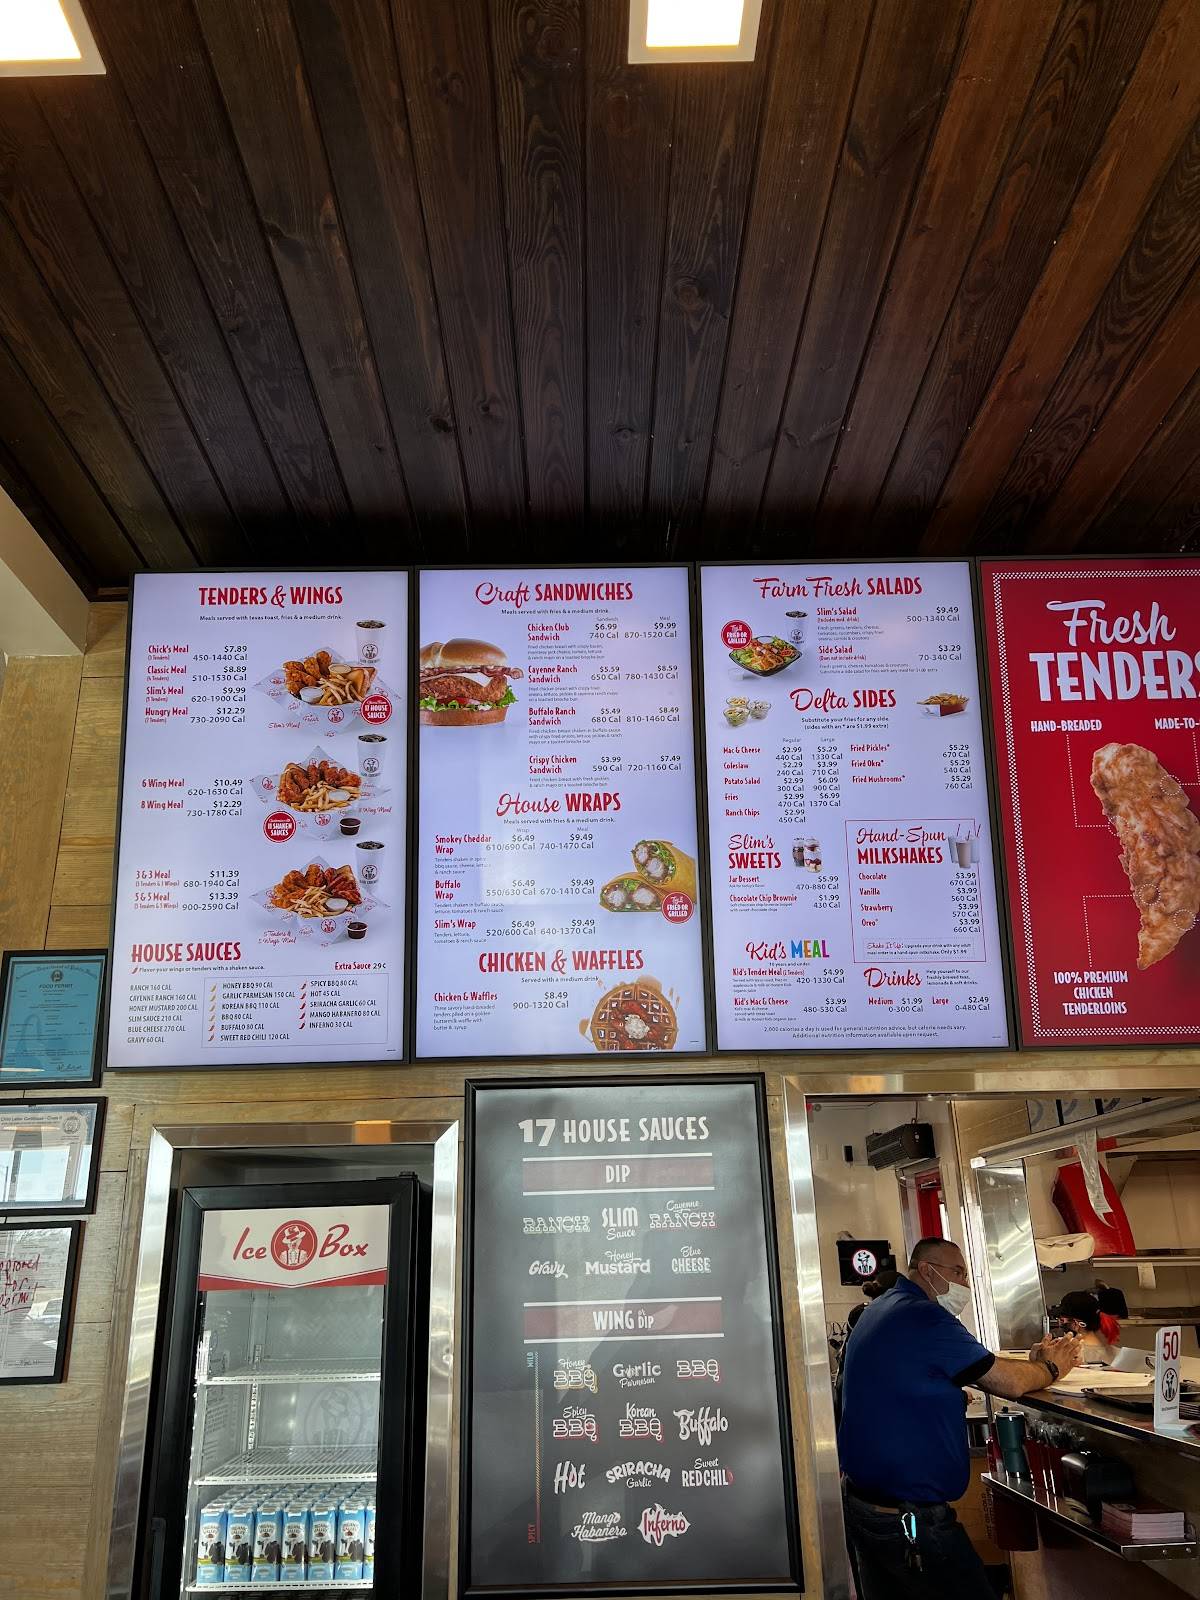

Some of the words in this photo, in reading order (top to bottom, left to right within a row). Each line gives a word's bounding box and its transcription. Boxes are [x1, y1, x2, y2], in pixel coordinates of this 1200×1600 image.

[476, 582, 530, 608] Craft
[535, 583, 633, 601] SANDWICHES
[753, 577, 809, 599] Farm
[806, 576, 863, 598] Fresh
[867, 577, 922, 596] SALADS
[199, 587, 267, 606] TENDERS
[271, 586, 286, 608] &
[290, 586, 343, 605] WINGS
[817, 608, 838, 616] Slim's
[839, 607, 857, 615] Salad
[654, 622, 676, 630] $9.99
[1046, 599, 1176, 647] Fresh
[528, 633, 560, 641] Sandwich
[148, 645, 171, 653] Chick's
[173, 645, 188, 653] Meal
[224, 645, 247, 653] $7.89
[819, 646, 833, 654] Side
[148, 666, 169, 674] Classic
[171, 666, 186, 674] Meal
[224, 666, 246, 674] $8.89
[1029, 650, 1200, 702] TENDER
[790, 688, 849, 713] Delta
[853, 690, 897, 708] SIDES
[146, 708, 170, 717] Hungry
[172, 708, 188, 716] Meal
[217, 707, 245, 716] $12.29
[529, 707, 554, 716] Buffalo
[556, 707, 576, 715] Ranch
[1031, 719, 1102, 732] HAND-BREADED
[1155, 718, 1200, 730] MADE-TO-
[723, 746, 734, 754] Mac
[148, 779, 166, 789] Wing
[168, 779, 184, 787] Meal
[214, 778, 242, 787] $10.49
[496, 793, 560, 816] House
[565, 793, 621, 812] WRAPS
[435, 835, 462, 844] Smokey
[464, 835, 491, 843] Cheddar
[728, 834, 775, 851] Slim's
[856, 826, 945, 845] Hand-Spun
[435, 846, 454, 855] Wrap
[857, 847, 944, 865] MILKSHAKES
[728, 852, 782, 869] SWEETS
[859, 873, 887, 881] Chocolate
[860, 888, 880, 896] Vanilla
[861, 904, 893, 913] Strawberry
[132, 943, 182, 962] HOUSE
[186, 942, 242, 961] SAUCES
[746, 942, 787, 961] Kid's
[791, 940, 829, 959] MEAL
[335, 962, 351, 970] Extra
[352, 962, 371, 970] Sauce
[479, 952, 546, 973] CHICKEN
[551, 950, 567, 974] &
[572, 950, 644, 970] WAFFLES
[747, 968, 767, 976] Tender
[768, 968, 782, 976] Meal
[863, 968, 922, 988] Drinks
[1054, 972, 1082, 985] 100%
[1083, 970, 1129, 983] PREMIUM
[434, 993, 462, 1001] Chicken
[463, 993, 468, 1001] &
[470, 992, 498, 1000] Waffles
[1073, 986, 1114, 999] CHICKEN
[869, 997, 893, 1005] Medium
[902, 997, 923, 1005] $1.99
[932, 997, 949, 1005] Large
[1063, 1002, 1127, 1015] TENDERLOINS
[518, 1119, 556, 1147] 17
[563, 1119, 631, 1143] HOUSE
[639, 1116, 710, 1142] SAUCES
[605, 1165, 631, 1183] DIP
[666, 1200, 700, 1213] Cayenne
[523, 1216, 591, 1234] RANCH
[601, 1207, 638, 1228] SLIM
[649, 1212, 717, 1229] RANCH
[606, 1228, 636, 1240] Sauce
[233, 1227, 266, 1261] Ice
[318, 1224, 368, 1259] Box
[605, 1250, 641, 1262] Honey
[680, 1246, 703, 1257] Blue
[529, 1260, 569, 1279] Gravy
[585, 1259, 650, 1275] Mustard
[671, 1257, 712, 1273] CHEESE
[593, 1310, 634, 1330] WING
[638, 1315, 654, 1329] DIP
[1163, 1331, 1178, 1361] 50
[558, 1358, 586, 1369] Honey
[677, 1359, 721, 1382] BBQ
[554, 1368, 598, 1393] BBQ
[563, 1406, 595, 1419] Spicy
[626, 1402, 656, 1418] Korean
[553, 1418, 599, 1443] BBQ
[619, 1418, 665, 1442] BBQ
[673, 1406, 728, 1446] Buffalo
[694, 1458, 719, 1469] Sweet
[554, 1460, 586, 1494] Hot
[606, 1461, 671, 1483] SRIRACHA
[681, 1470, 702, 1487] RED
[626, 1478, 652, 1488] Garlic
[582, 1511, 621, 1524] Mango
[571, 1524, 627, 1542] Habanero
[643, 1510, 686, 1544] Inferno
